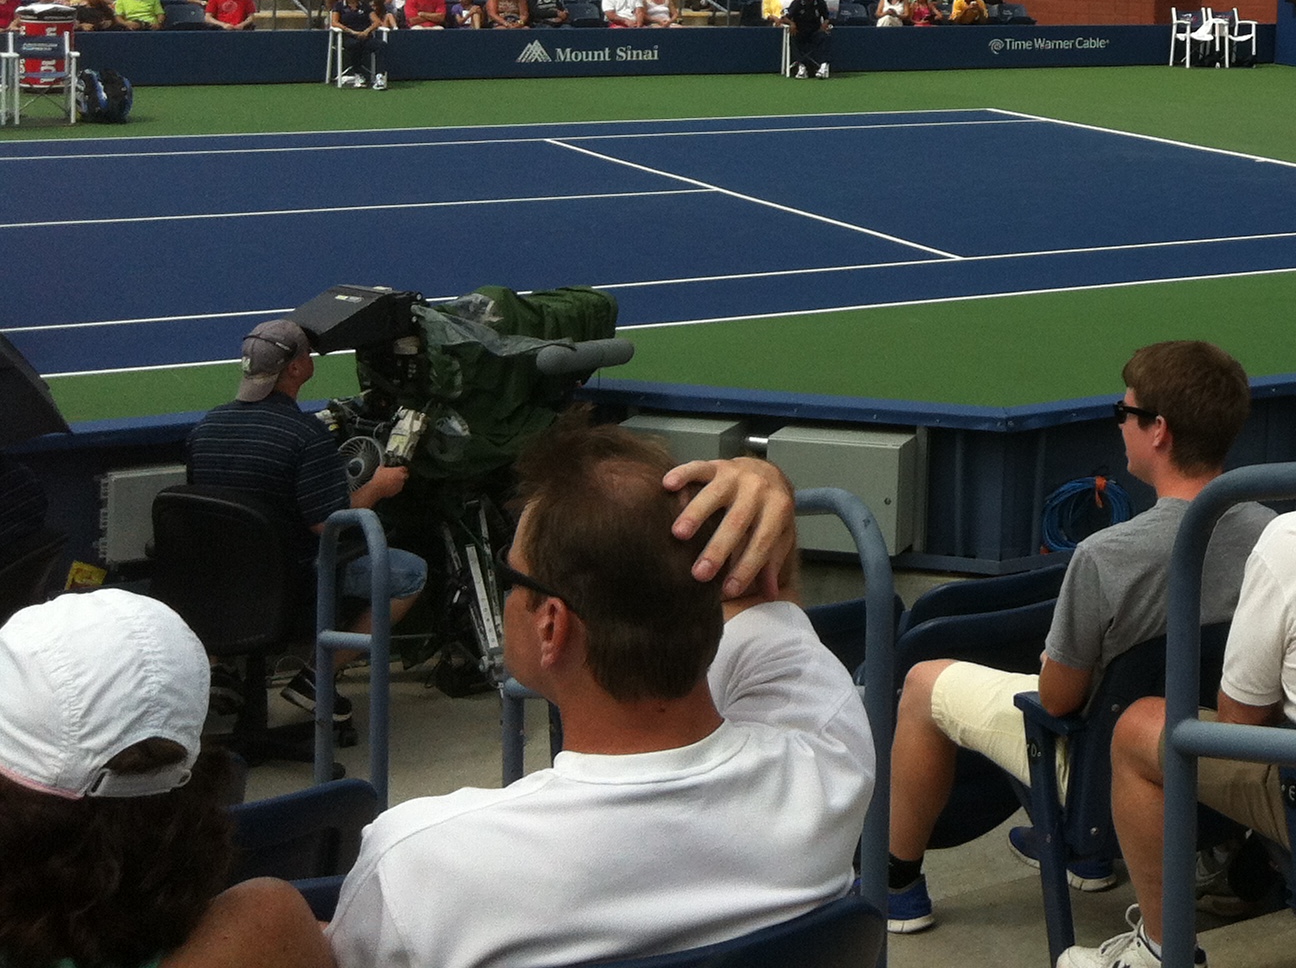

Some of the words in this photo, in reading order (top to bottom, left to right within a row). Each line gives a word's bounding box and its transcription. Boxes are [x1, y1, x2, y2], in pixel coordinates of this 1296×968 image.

[1004, 38, 1033, 50] Time
[1034, 37, 1075, 50] Warner
[1075, 36, 1107, 49] Cable
[554, 46, 611, 62] Mount
[615, 45, 659, 61] Sinai
